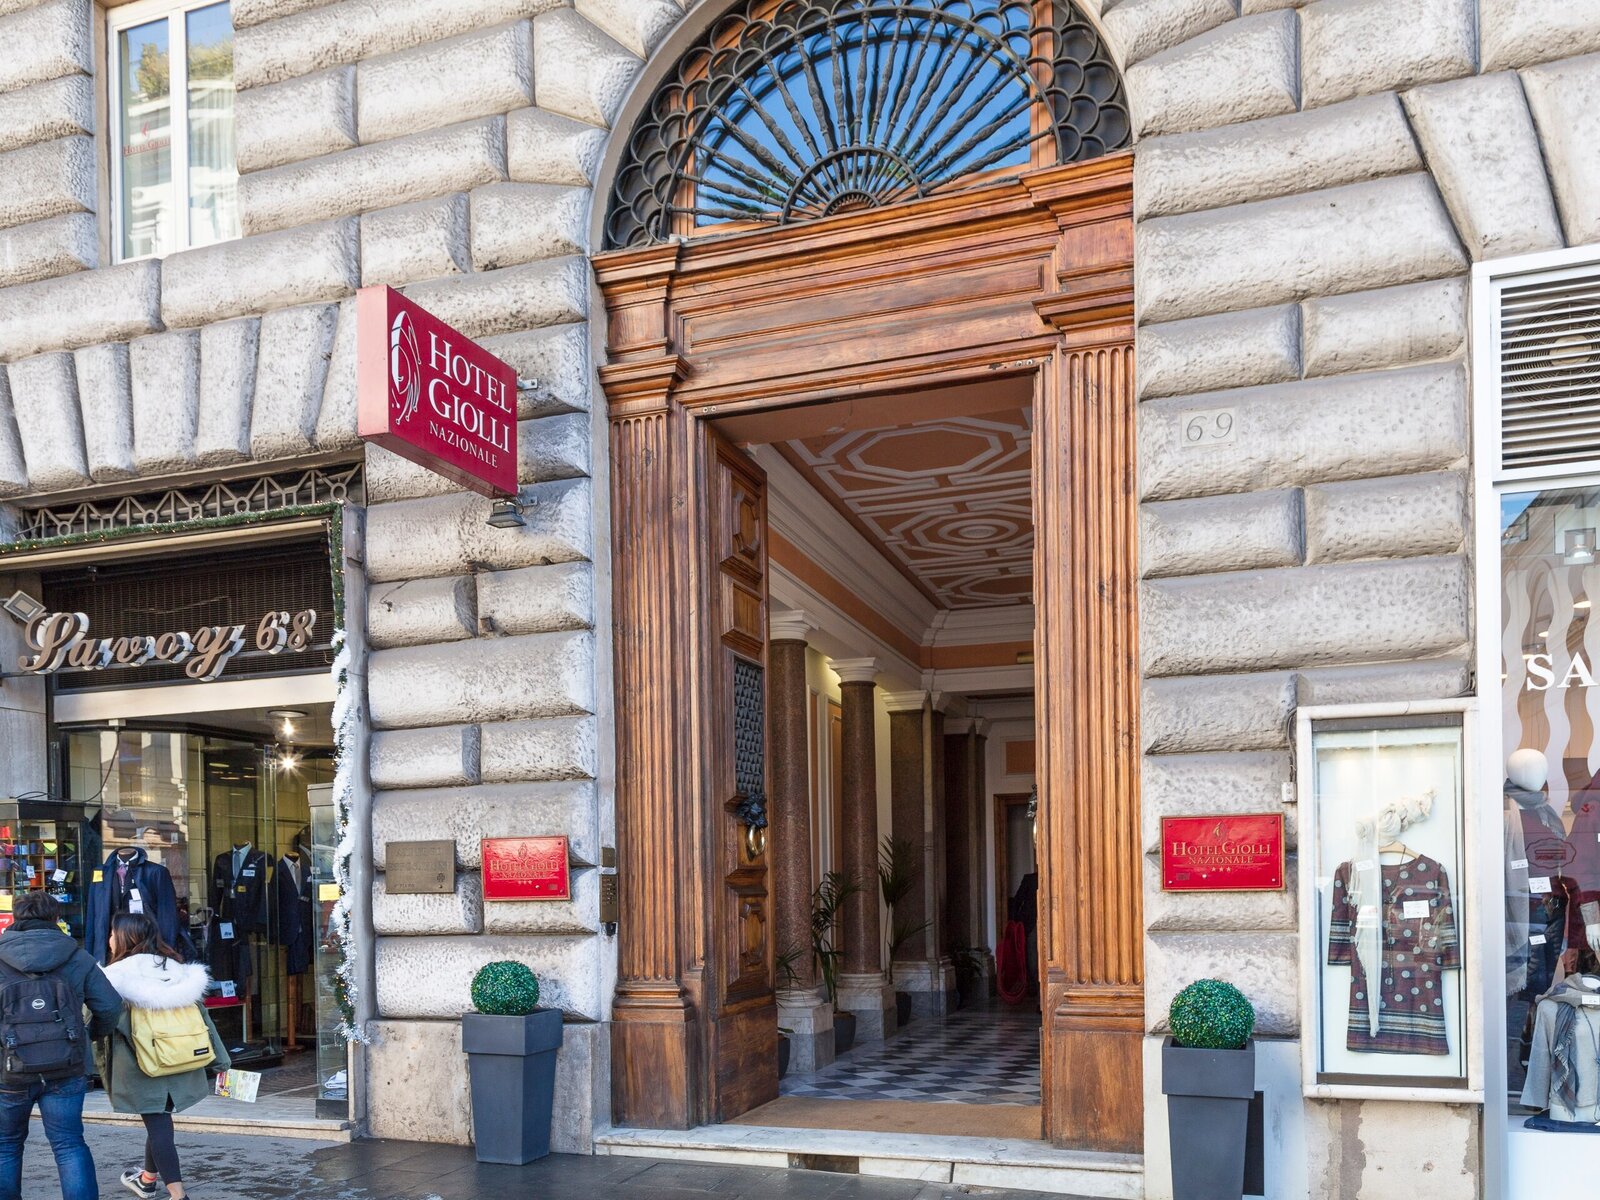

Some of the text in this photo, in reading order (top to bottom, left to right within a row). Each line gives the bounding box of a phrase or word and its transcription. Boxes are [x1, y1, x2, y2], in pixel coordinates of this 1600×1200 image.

[428, 330, 512, 413] HOTEL
[428, 378, 510, 453] GIOLLI
[1186, 412, 1233, 442] 69
[429, 420, 498, 468] NAZIONALE
[17, 608, 317, 682] Savoy 68
[1172, 841, 1271, 856] HOTEL GIOLLI
[1188, 855, 1253, 865] NAZIONALE
